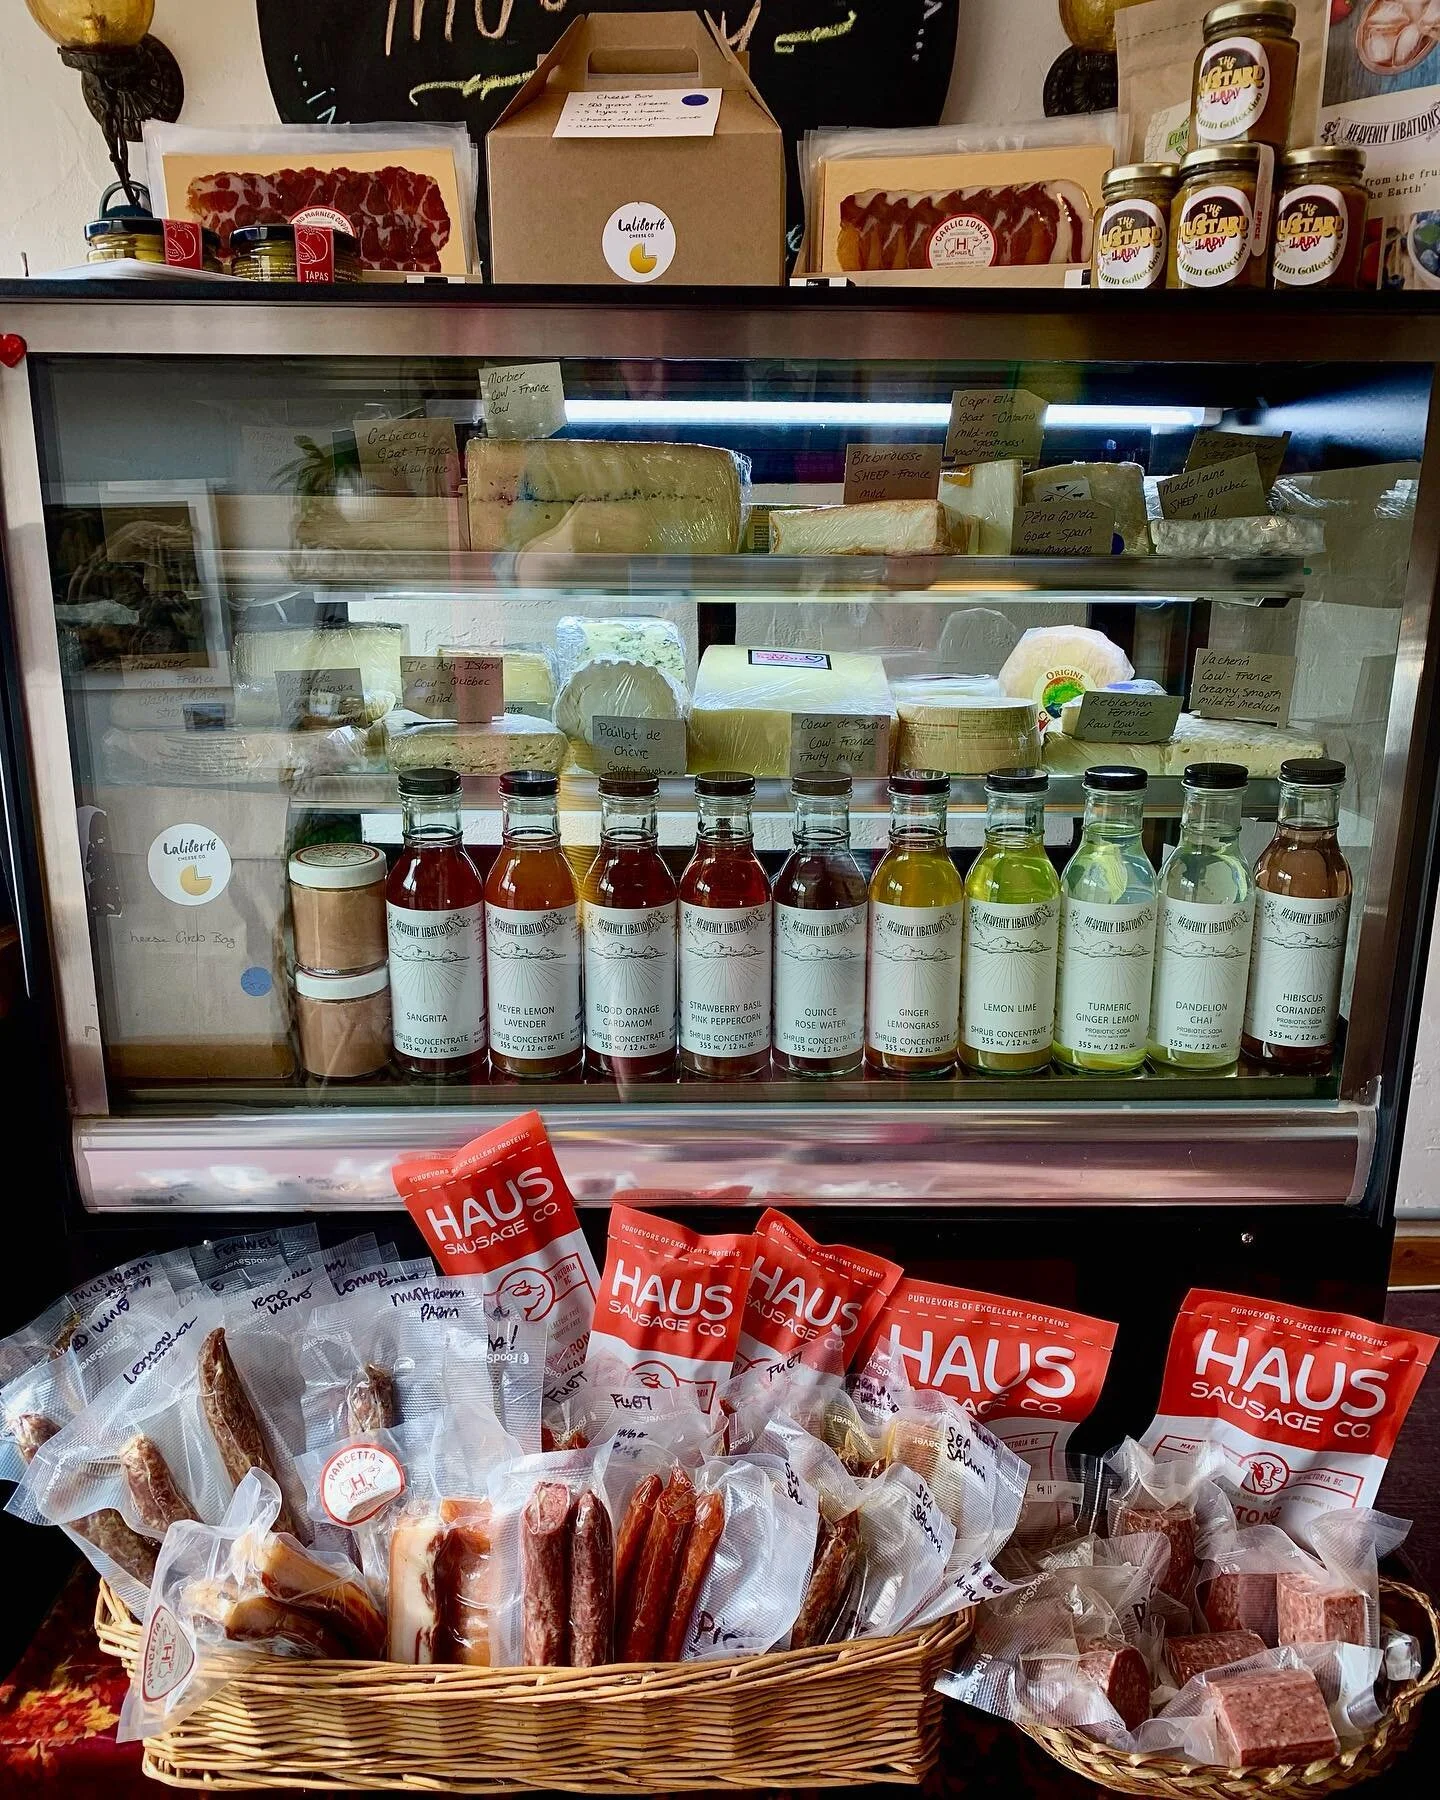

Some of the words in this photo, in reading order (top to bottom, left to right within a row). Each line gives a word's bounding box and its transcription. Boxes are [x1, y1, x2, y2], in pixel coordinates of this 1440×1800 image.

[1217, 55, 1237, 69] THE
[1346, 122, 1390, 144] HEAVENLY
[1391, 108, 1440, 142] LIBATIONS
[1365, 176, 1391, 187] from
[1395, 172, 1415, 182] the
[1202, 203, 1223, 217] THE
[1298, 202, 1319, 217] THE
[617, 215, 667, 232] Laliberté
[935, 219, 964, 242] GARLIC
[965, 219, 989, 240] LONZA
[956, 237, 967, 250] H
[304, 270, 329, 281] TAPAS
[163, 838, 217, 856] Laliberté
[981, 912, 1010, 929] HEAVENLY
[1011, 912, 1042, 930] LIBATIONS
[1280, 907, 1312, 925] HEAVENLY
[1313, 907, 1342, 925] LIBATIONS
[395, 918, 420, 938] HEAVENLY
[421, 920, 453, 939] LIBATIONS
[494, 917, 518, 935] HEAVENLY
[519, 919, 550, 936] LIBATIONS
[597, 917, 623, 935] HEAVENLY
[625, 919, 655, 935] LIBATIONS
[695, 916, 722, 935] HEAVENLY
[723, 917, 753, 935] LIBATIONS
[792, 920, 820, 937] HEAVENLY
[821, 920, 850, 937] LIBATIONS
[886, 919, 914, 938] HEAVENLY
[916, 920, 946, 938] LIBATIONS
[1084, 915, 1114, 933] HEAVENLY
[1115, 916, 1144, 933] LIBATIONS
[1177, 915, 1207, 934] HEAVENLY
[1208, 916, 1239, 934] LIBATIONS
[1282, 992, 1323, 1002] HIBISCUS
[497, 1003, 521, 1015] MEYER
[524, 1005, 555, 1017] LEMON
[596, 1003, 622, 1015] BLOOD
[625, 1004, 660, 1015] ORANGE
[689, 1001, 740, 1013] STRAWBERRY
[743, 1000, 762, 1011] BASIL
[804, 1007, 837, 1017] QUINCE
[898, 1008, 929, 1017] GINGER
[983, 1003, 1014, 1013] LEMON
[1017, 1003, 1037, 1013] LIME
[1087, 1002, 1132, 1011] TURMERIC
[1175, 1001, 1228, 1012] DANDELION
[1275, 1004, 1326, 1015] CORIANDER
[406, 1012, 448, 1023] SANGRITA
[503, 1018, 547, 1028] LAVENDER
[602, 1017, 653, 1028] CARDAMOM
[691, 1013, 707, 1024] PINK
[710, 1013, 761, 1025] PEPPERCORN
[795, 1019, 816, 1029] ROSE
[819, 1019, 847, 1029] WATER
[887, 1019, 940, 1030] LEMONGRASS
[1075, 1013, 1108, 1024] GINGER
[1112, 1013, 1140, 1024] LEMON
[1189, 1016, 1213, 1025] CHAI
[1276, 1017, 1307, 1025] PROBIOTIC
[591, 1029, 612, 1041] SHRUB
[615, 1031, 666, 1043] CONCENTRATE
[689, 1029, 712, 1042] SHRUB
[713, 1029, 763, 1042] CONCENTRATE
[970, 1025, 994, 1037] SHRUB
[997, 1025, 1047, 1038] CONCENTRATE
[1085, 1027, 1116, 1035] PROBIOTIC
[1176, 1026, 1207, 1034] PROBIOTIC
[1269, 1029, 1283, 1038] 355
[414, 1034, 469, 1046] CONCENTRATE
[512, 1032, 566, 1045] CONCENTRATE
[783, 1032, 806, 1044] SHRUB
[808, 1032, 857, 1045] CONCENTRATE
[875, 1032, 897, 1044] SHRUB
[899, 1033, 951, 1045] CONCENTRATE
[981, 1036, 995, 1045] 355
[460, 1148, 497, 1168] EXCELLENT
[497, 1131, 530, 1150] PROTEINS
[425, 1166, 554, 1242] HAUS
[443, 1219, 529, 1256] SAUSAGE
[533, 1202, 561, 1222] CO.
[621, 1223, 660, 1242] PURVEYORS
[660, 1237, 670, 1245] OF
[671, 1239, 707, 1255] EXCELLENT
[708, 1249, 741, 1258] PROTEINS
[611, 1259, 734, 1321] HAUS
[750, 1255, 863, 1336] HAUS
[907, 1293, 960, 1310] PURVEYORS
[962, 1302, 974, 1311] OF
[974, 1303, 1024, 1319] EXCELLENT
[1026, 1312, 1070, 1329] PROTEINS
[608, 1300, 689, 1333] SAUSAGE
[697, 1322, 727, 1338] CO.
[1230, 1306, 1281, 1323] PURVEYORS
[1283, 1317, 1294, 1326] OF
[1296, 1321, 1343, 1337] EXCELLENT
[1344, 1330, 1390, 1347] PROTEINS
[889, 1323, 1076, 1399] HAUS
[1195, 1328, 1390, 1418] HAUS
[1190, 1381, 1325, 1434] SAUSAGE
[1333, 1421, 1371, 1439] CO.
[329, 1450, 376, 1482] PANCETTA
[350, 1475, 365, 1491] H
